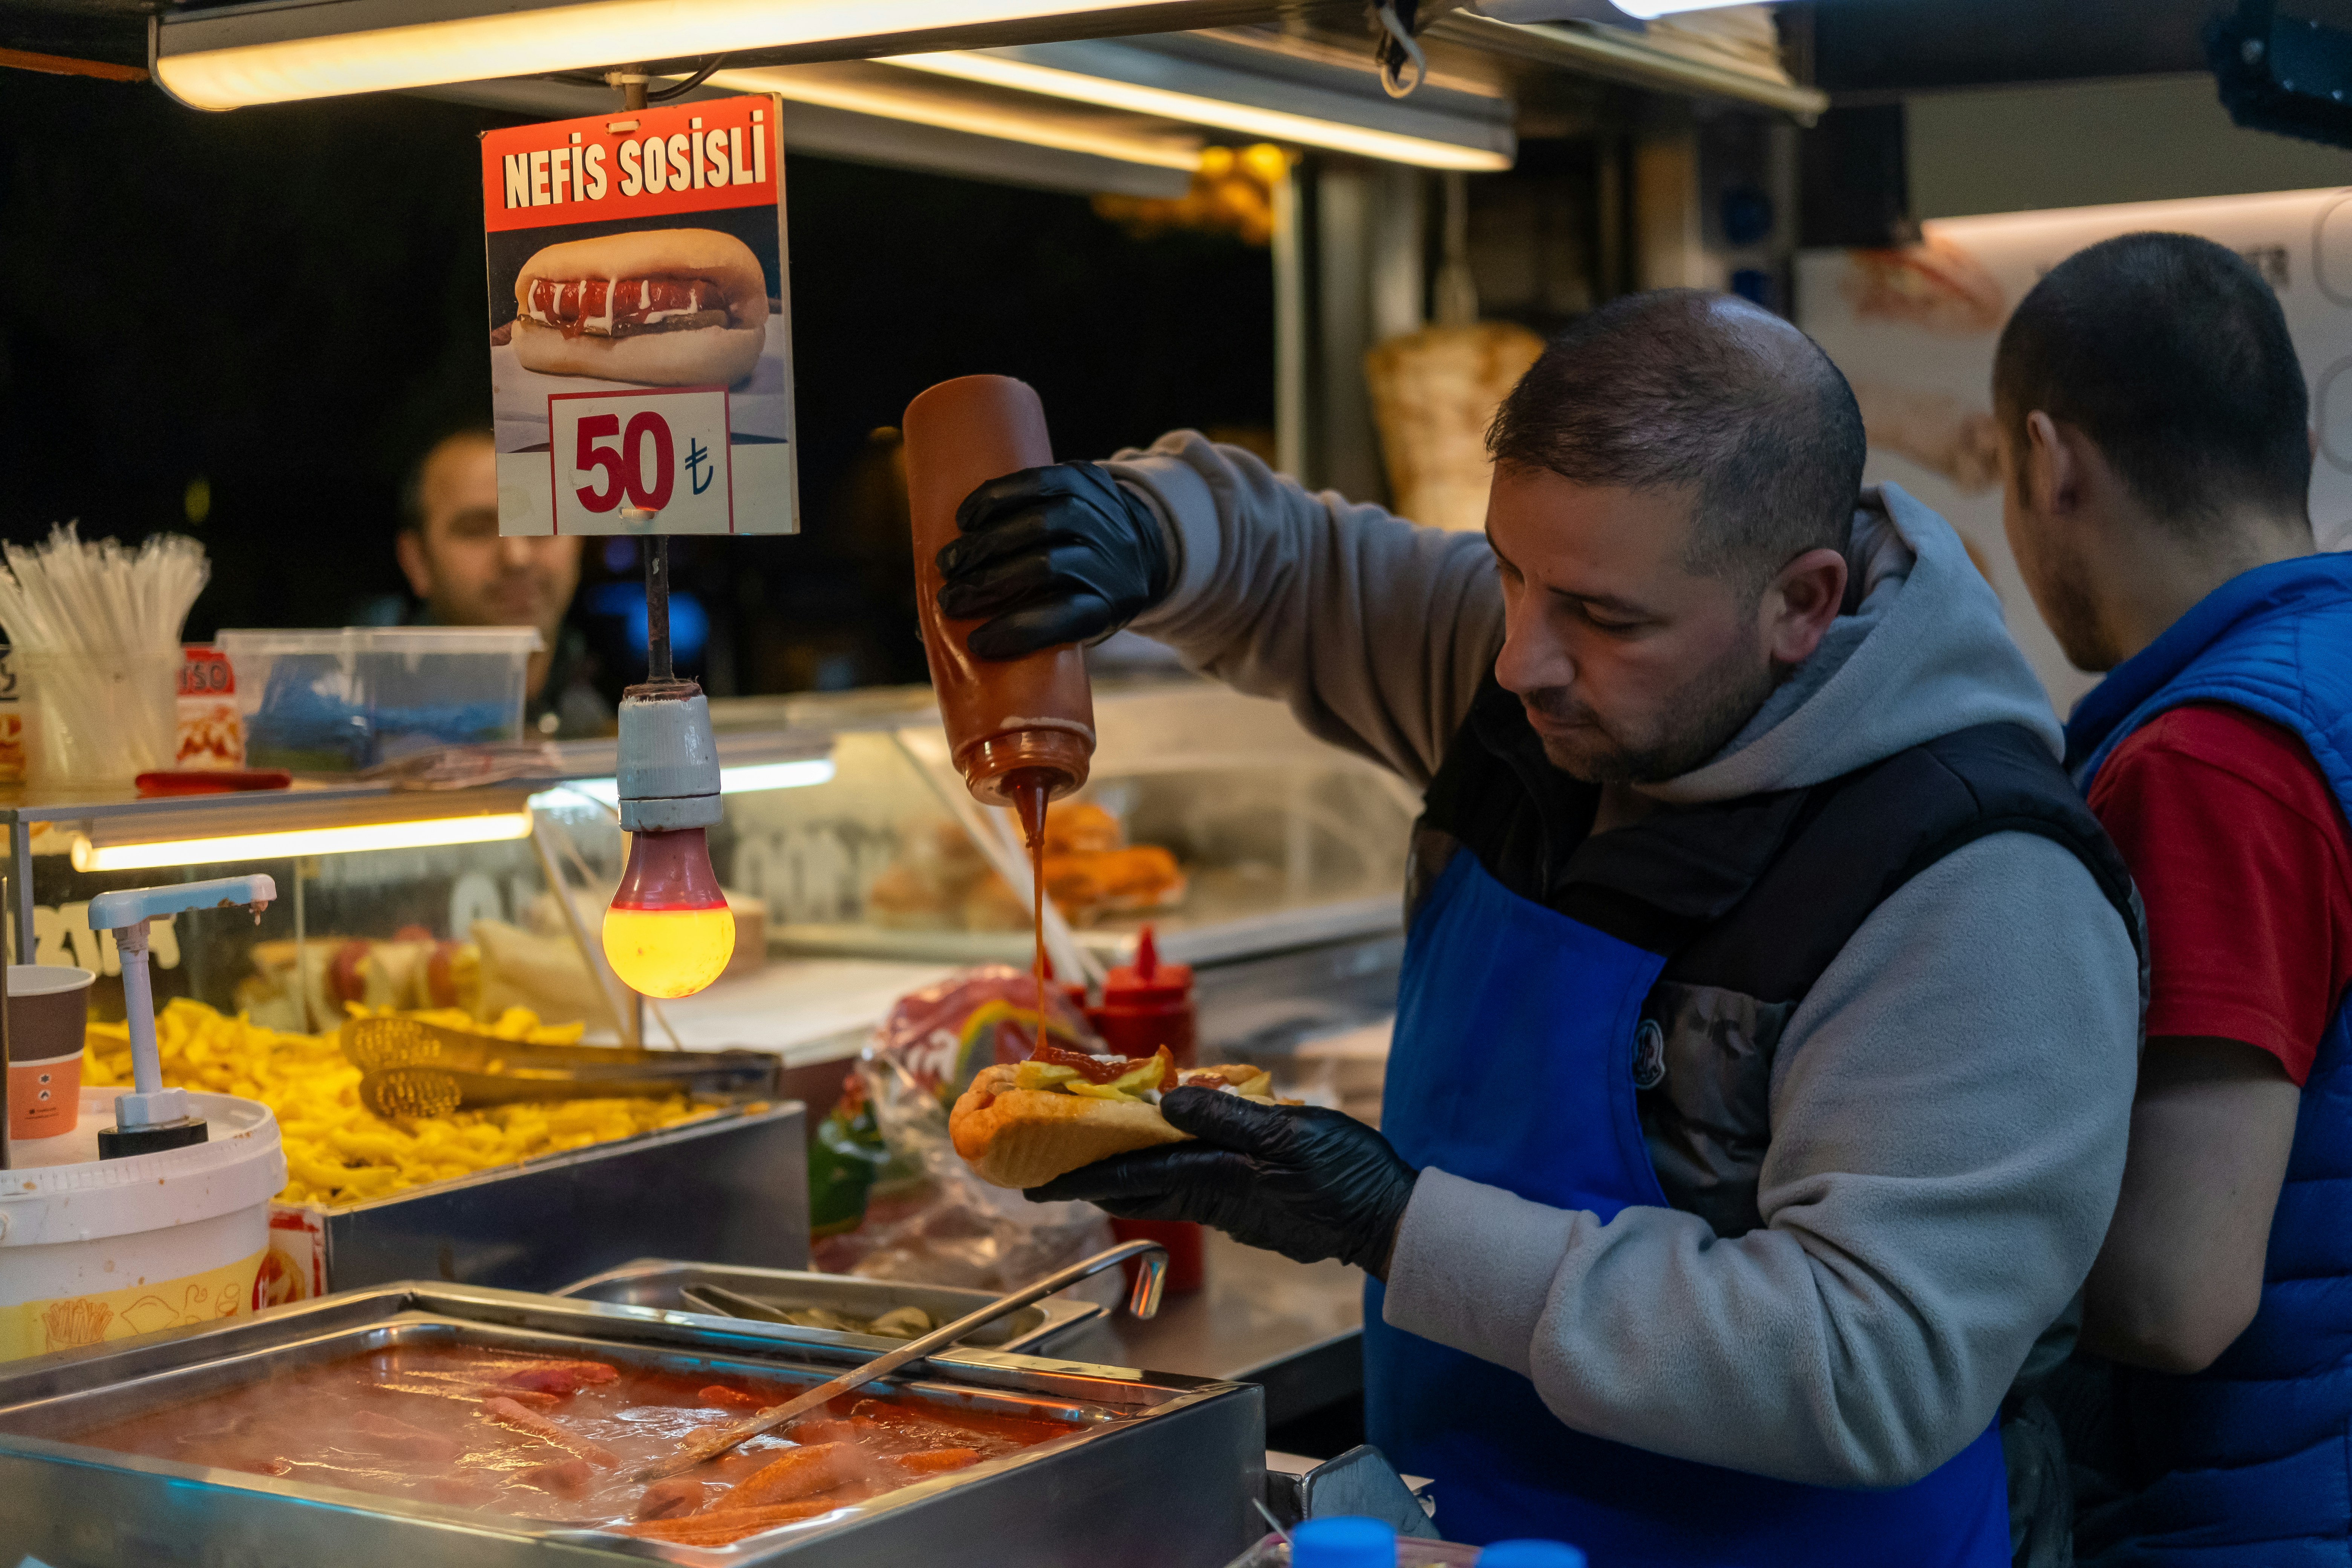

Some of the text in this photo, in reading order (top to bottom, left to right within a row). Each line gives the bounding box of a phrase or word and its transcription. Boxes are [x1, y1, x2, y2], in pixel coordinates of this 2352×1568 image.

[502, 109, 766, 209] NEFİS SOSİSLİ
[576, 411, 675, 513] 50
